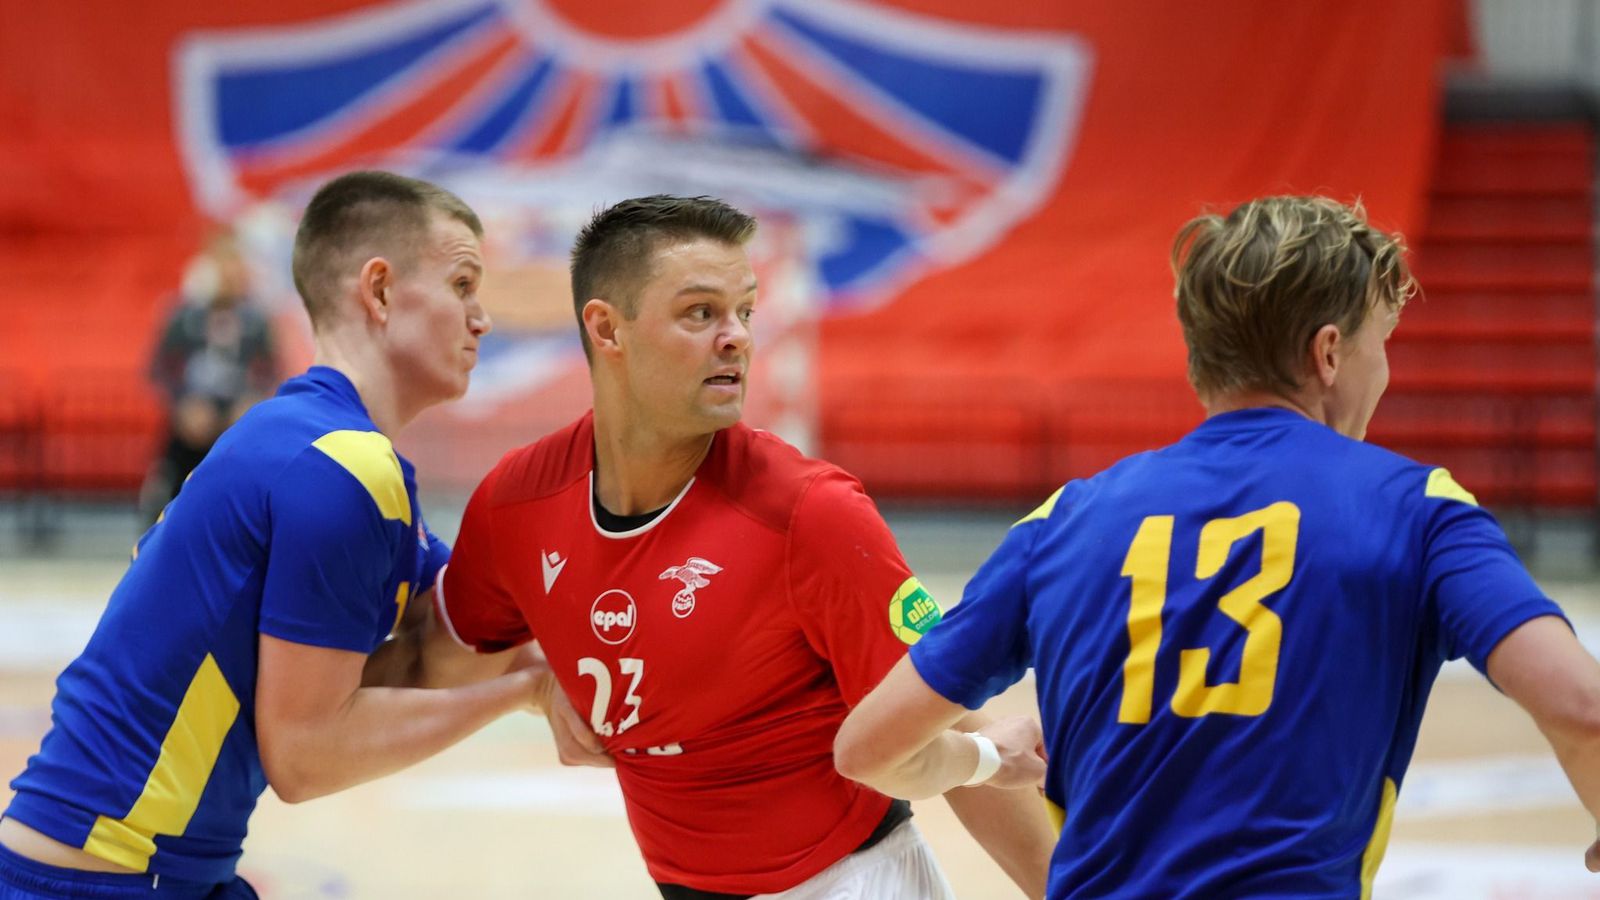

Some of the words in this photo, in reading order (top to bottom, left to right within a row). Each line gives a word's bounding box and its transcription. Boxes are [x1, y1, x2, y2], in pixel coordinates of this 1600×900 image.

[594, 604, 633, 632] epal
[907, 597, 936, 625] olis
[1117, 500, 1301, 724] 13
[577, 657, 644, 737] 23
